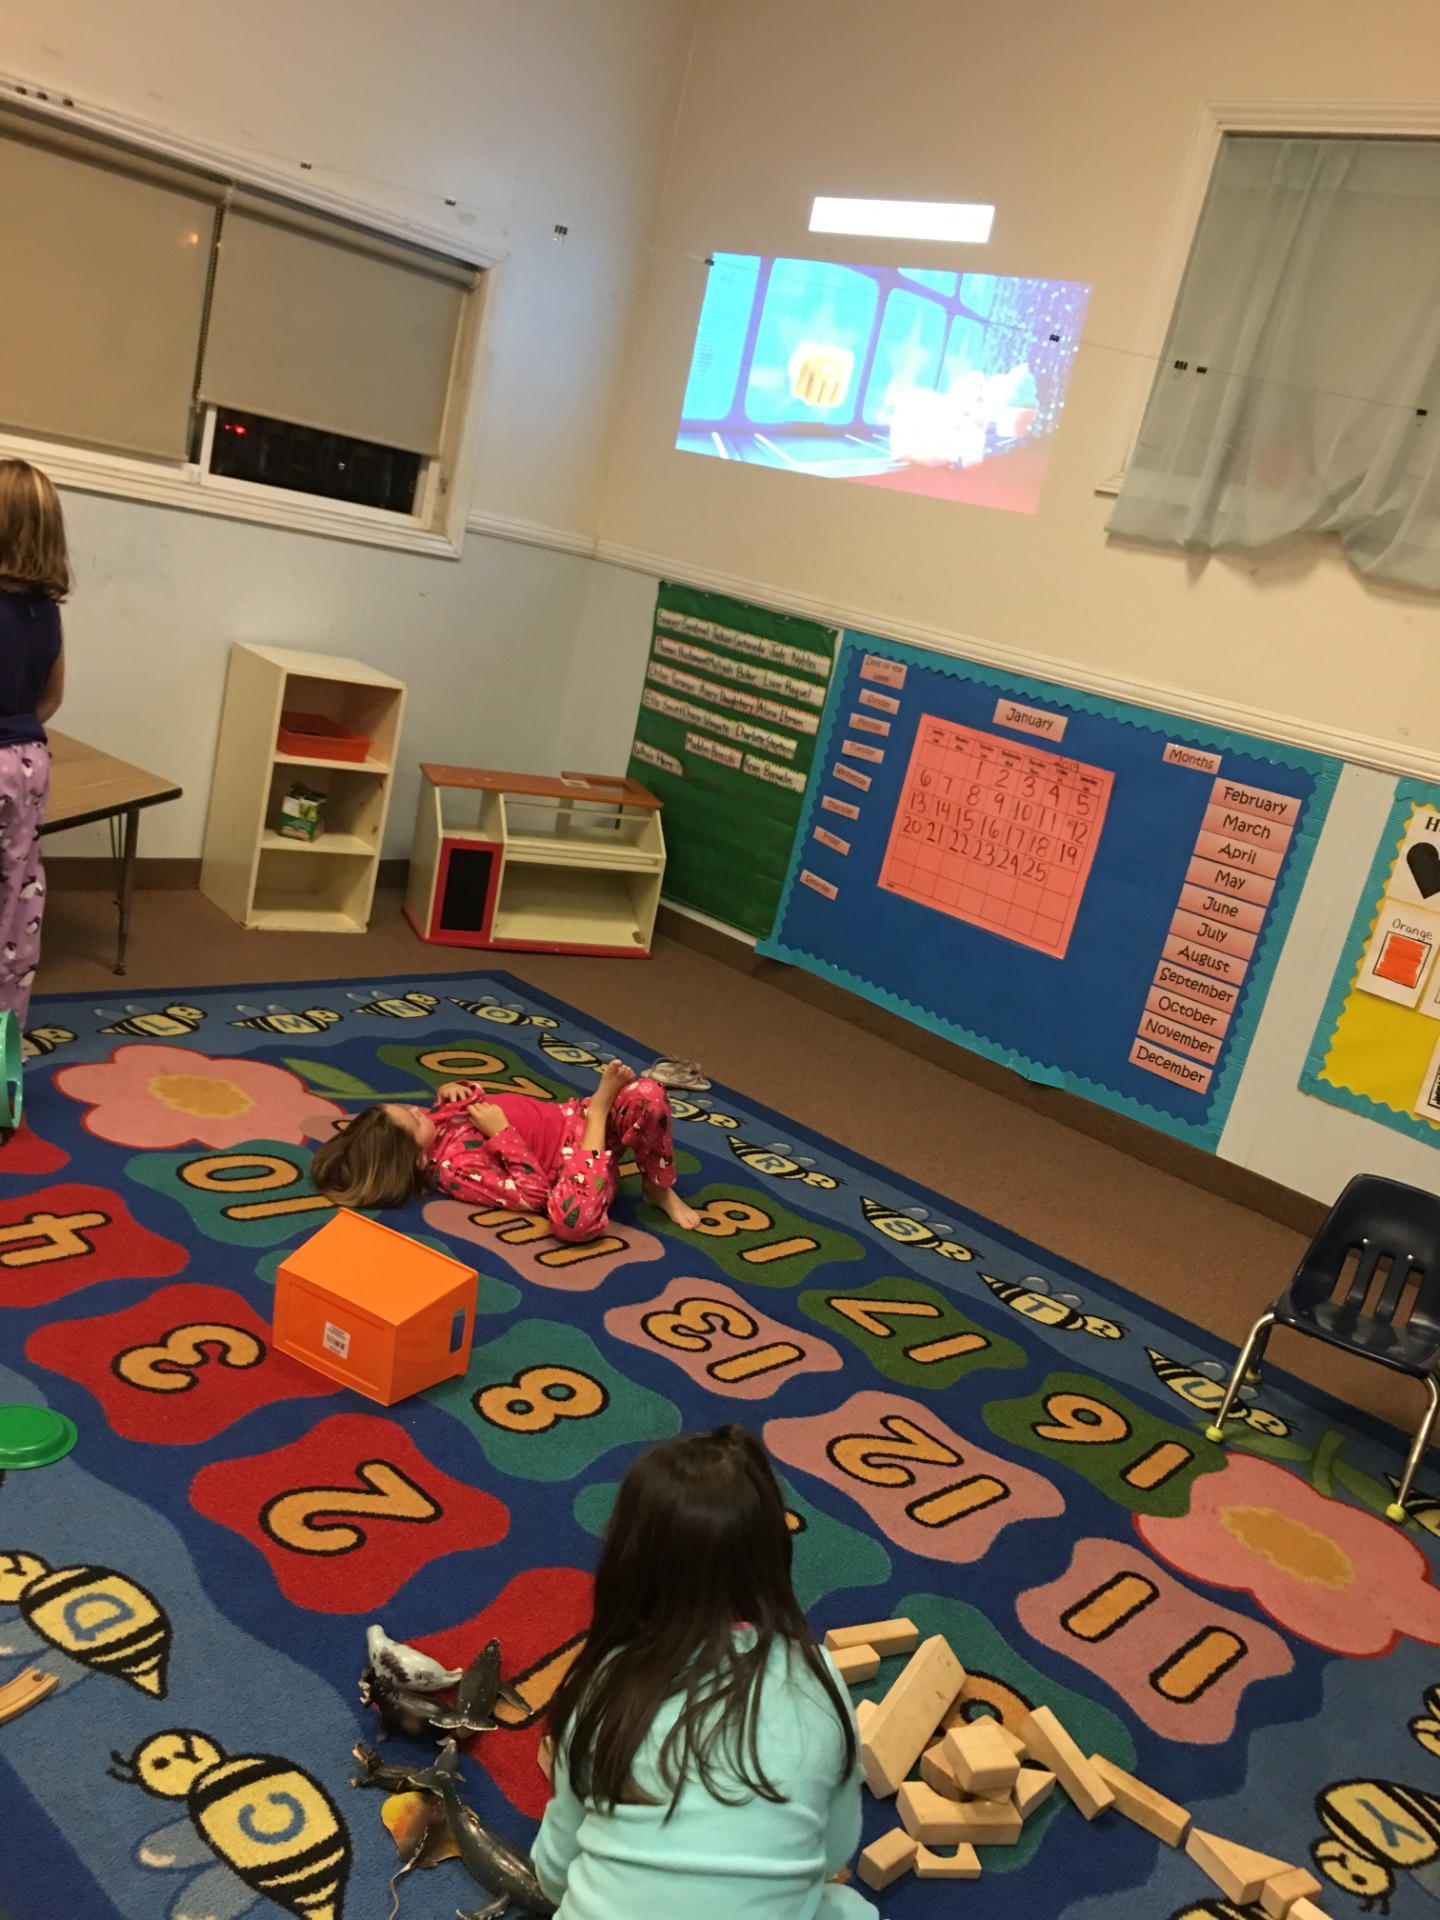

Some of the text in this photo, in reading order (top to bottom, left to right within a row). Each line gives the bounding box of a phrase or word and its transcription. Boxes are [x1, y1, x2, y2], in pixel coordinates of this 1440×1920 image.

[857, 717, 883, 732] Monday
[1006, 707, 1054, 731] January
[1169, 749, 1214, 770] Months
[920, 769, 1088, 844] 6 7 8 9 10 11 12
[976, 761, 983, 780] 1
[995, 769, 1010, 789] 2
[1021, 776, 1036, 798] 3
[1048, 785, 1060, 807] 4
[1076, 794, 1090, 816] 5
[1223, 786, 1287, 815] February
[911, 792, 1078, 865] 13 14 15 16 17 18 19
[1222, 814, 1271, 840] March
[902, 816, 1046, 882] 20 21 22 23 24 25
[1218, 843, 1257, 865] April
[1215, 870, 1246, 890] May
[1203, 896, 1239, 918] June
[1197, 923, 1228, 943] July
[1391, 917, 1433, 942] Orange
[1177, 945, 1230, 973] August
[1159, 966, 1234, 1003] September
[1158, 996, 1217, 1026] October
[1145, 1018, 1215, 1054] November
[1136, 1045, 1206, 1083] December
[754, 1155, 786, 1172] R
[883, 1219, 920, 1237] S
[1023, 1295, 1063, 1314] T
[641, 1296, 806, 1385] 13
[826, 1294, 992, 1365] 17
[111, 1322, 267, 1394] 3
[472, 1364, 610, 1434] 8
[1030, 1391, 1196, 1491] 16
[826, 1415, 1011, 1528] 12
[259, 1459, 444, 1557] 2
[62, 1591, 137, 1642] D
[237, 1791, 306, 1844] C
[1353, 1797, 1427, 1850] Y
